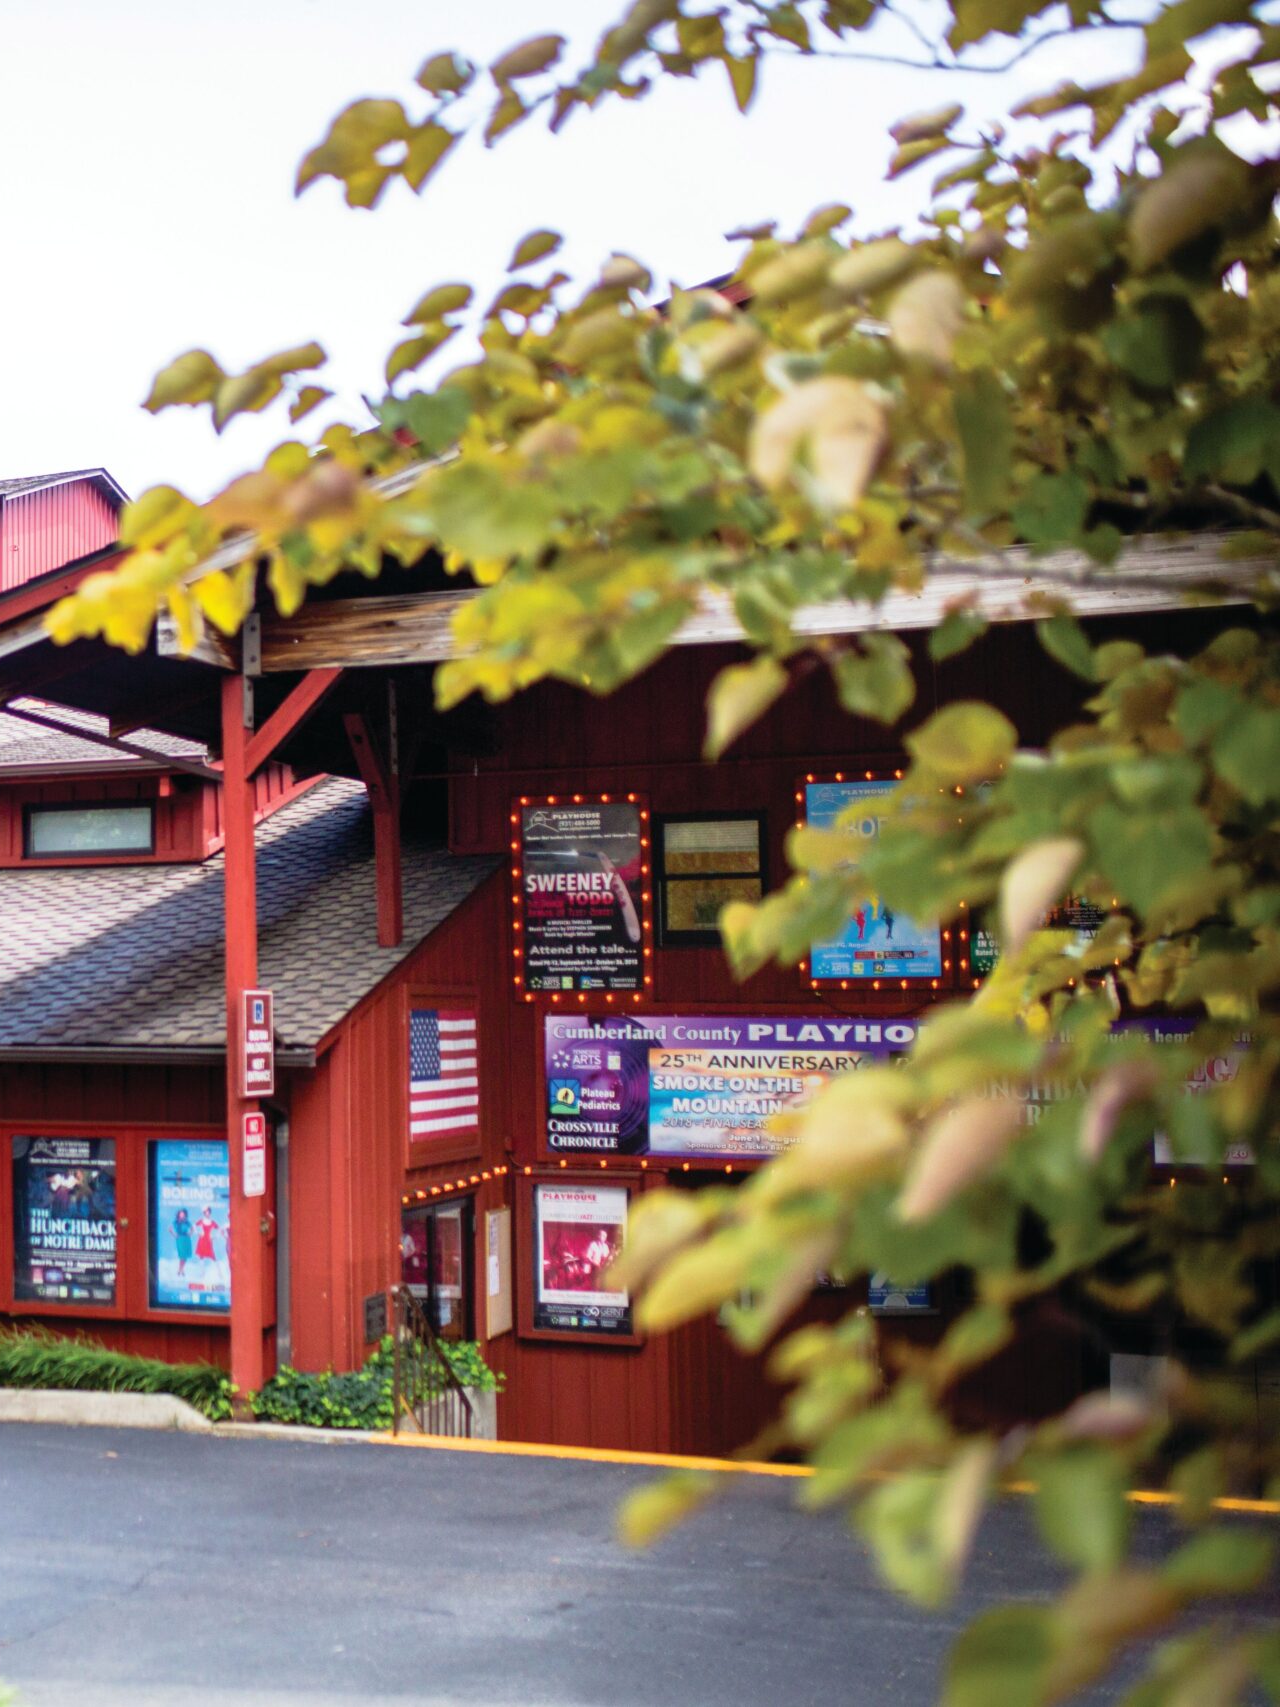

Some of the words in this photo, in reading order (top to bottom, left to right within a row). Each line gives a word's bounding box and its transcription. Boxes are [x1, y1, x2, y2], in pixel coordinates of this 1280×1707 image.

[552, 812, 600, 820] PLAYHOUSE
[526, 872, 614, 893] SWEENEY
[566, 891, 614, 906] TODD
[530, 945, 573, 955] Attend
[576, 944, 597, 954] the
[601, 944, 637, 954] tale...
[553, 1024, 667, 1040] Cumberland
[673, 1025, 742, 1046] County
[748, 1024, 928, 1043] PLAYHO
[573, 1055, 601, 1065] ARTS
[660, 1054, 702, 1068] 25TH
[708, 1055, 863, 1071] ANNIVERSARY
[653, 1075, 724, 1091] SMOKE
[729, 1076, 759, 1092] ON
[764, 1077, 804, 1093] THE
[581, 1088, 615, 1098] Plateau
[577, 1099, 621, 1111] Pediatrics
[672, 1097, 784, 1115] MOUNTAIN
[548, 1119, 620, 1133] CROSSVILLE
[662, 1117, 692, 1127] 2018
[702, 1118, 737, 1128] FINAL
[739, 1118, 769, 1129] SEAS
[550, 1134, 618, 1148] CHRONICLE
[729, 1135, 752, 1143] June
[687, 1142, 726, 1150] Sponsored
[728, 1143, 738, 1151] by
[162, 1187, 215, 1201] BOEING
[543, 1192, 597, 1201] PLAYHOUSE
[31, 1208, 50, 1217] THE
[31, 1218, 117, 1236] HUNCHBACK
[44, 1235, 83, 1249] NOTRE
